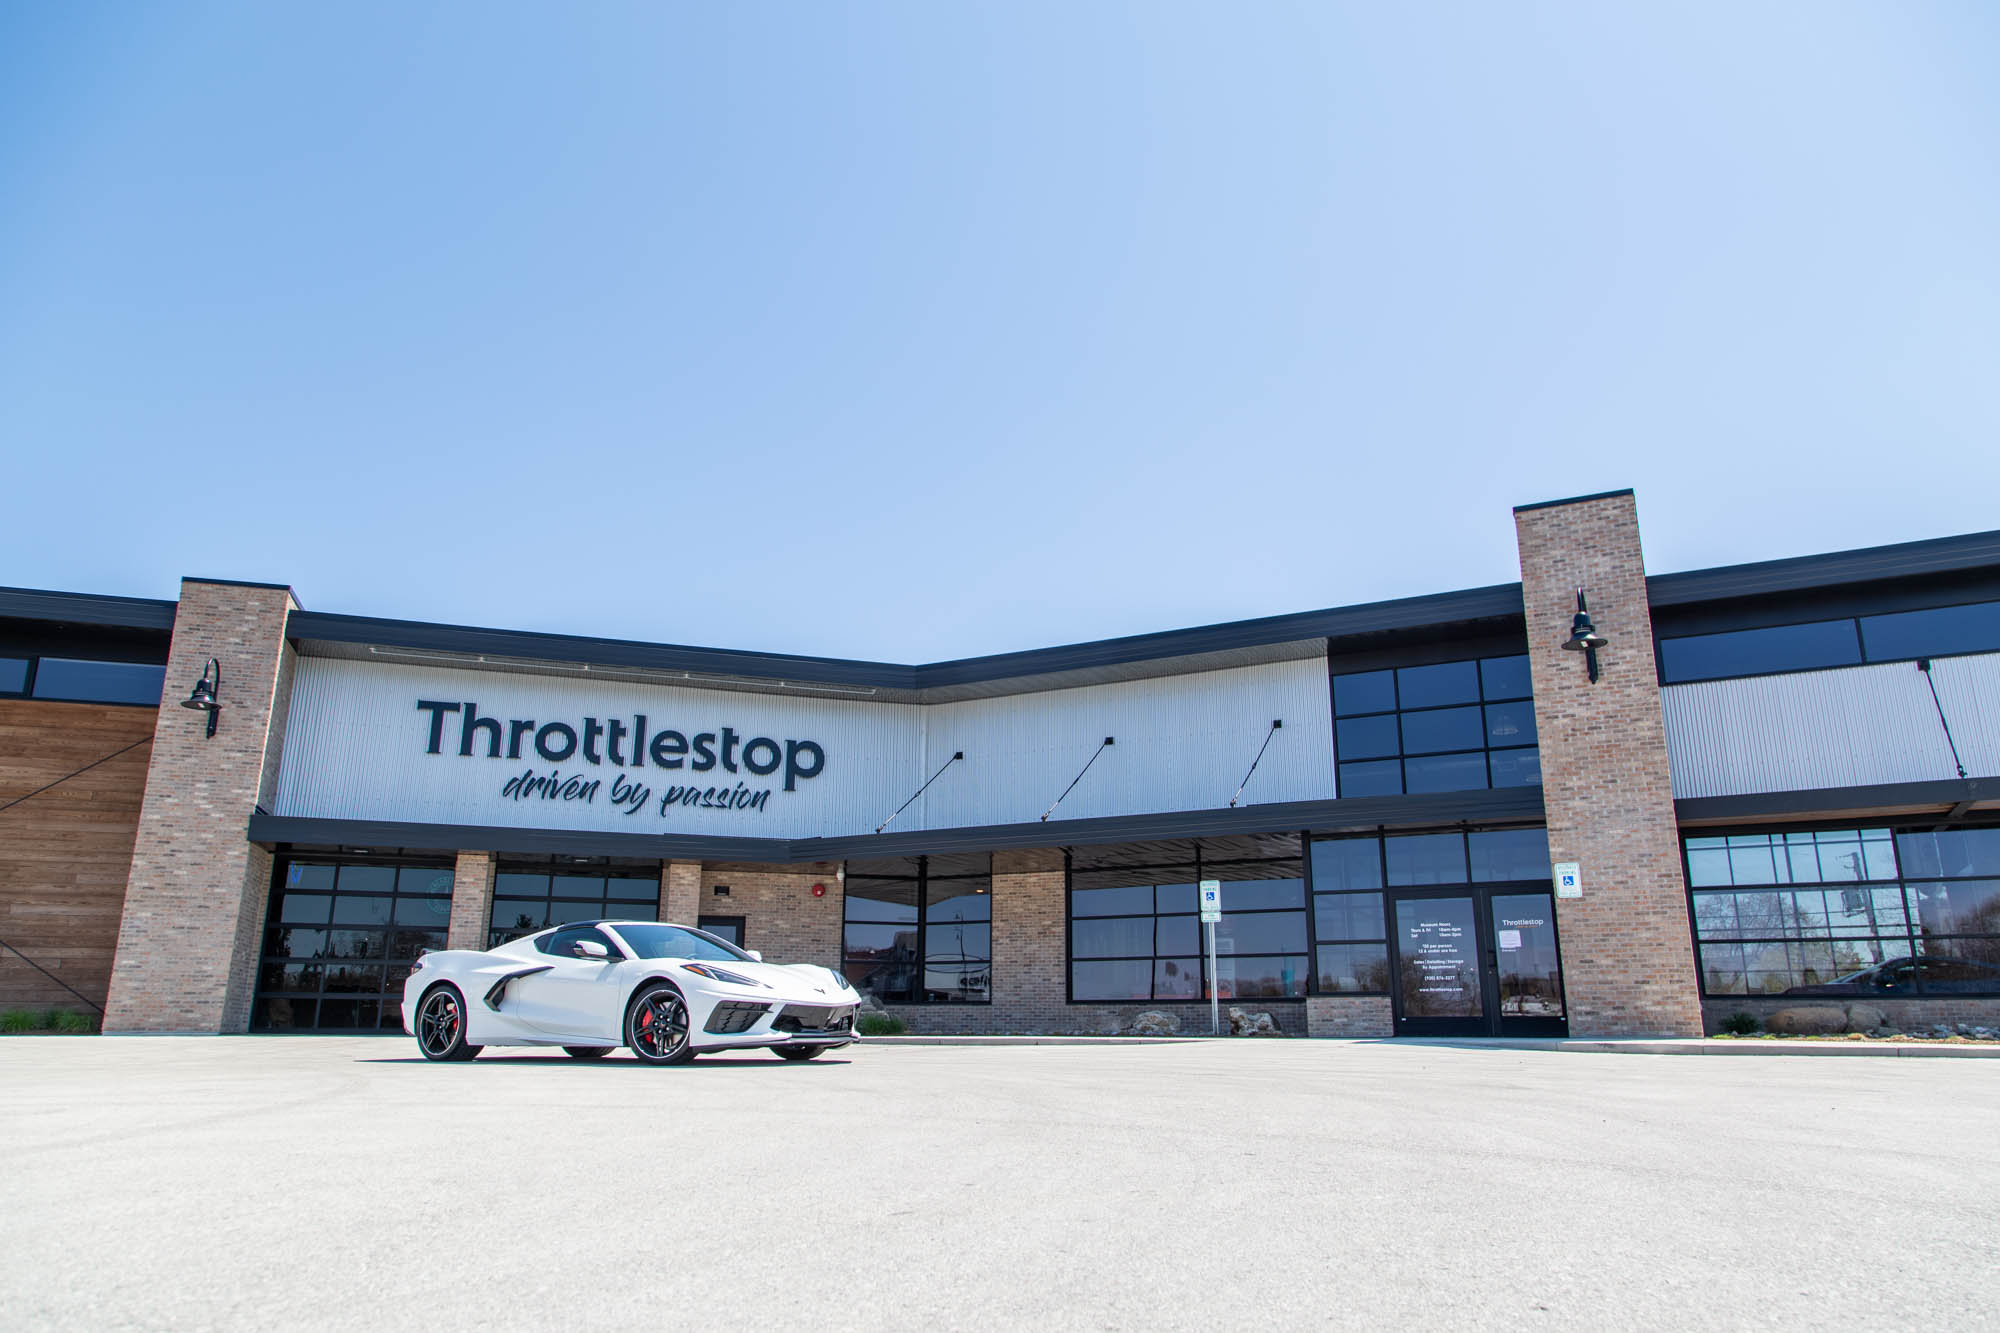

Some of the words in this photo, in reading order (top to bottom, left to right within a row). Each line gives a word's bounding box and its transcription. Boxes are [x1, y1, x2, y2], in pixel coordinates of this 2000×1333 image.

[417, 699, 825, 792] Throttlestop
[502, 768, 601, 803] driven
[610, 773, 651, 815] by
[661, 781, 771, 817] passion
[1502, 919, 1544, 927] Throttlestop
